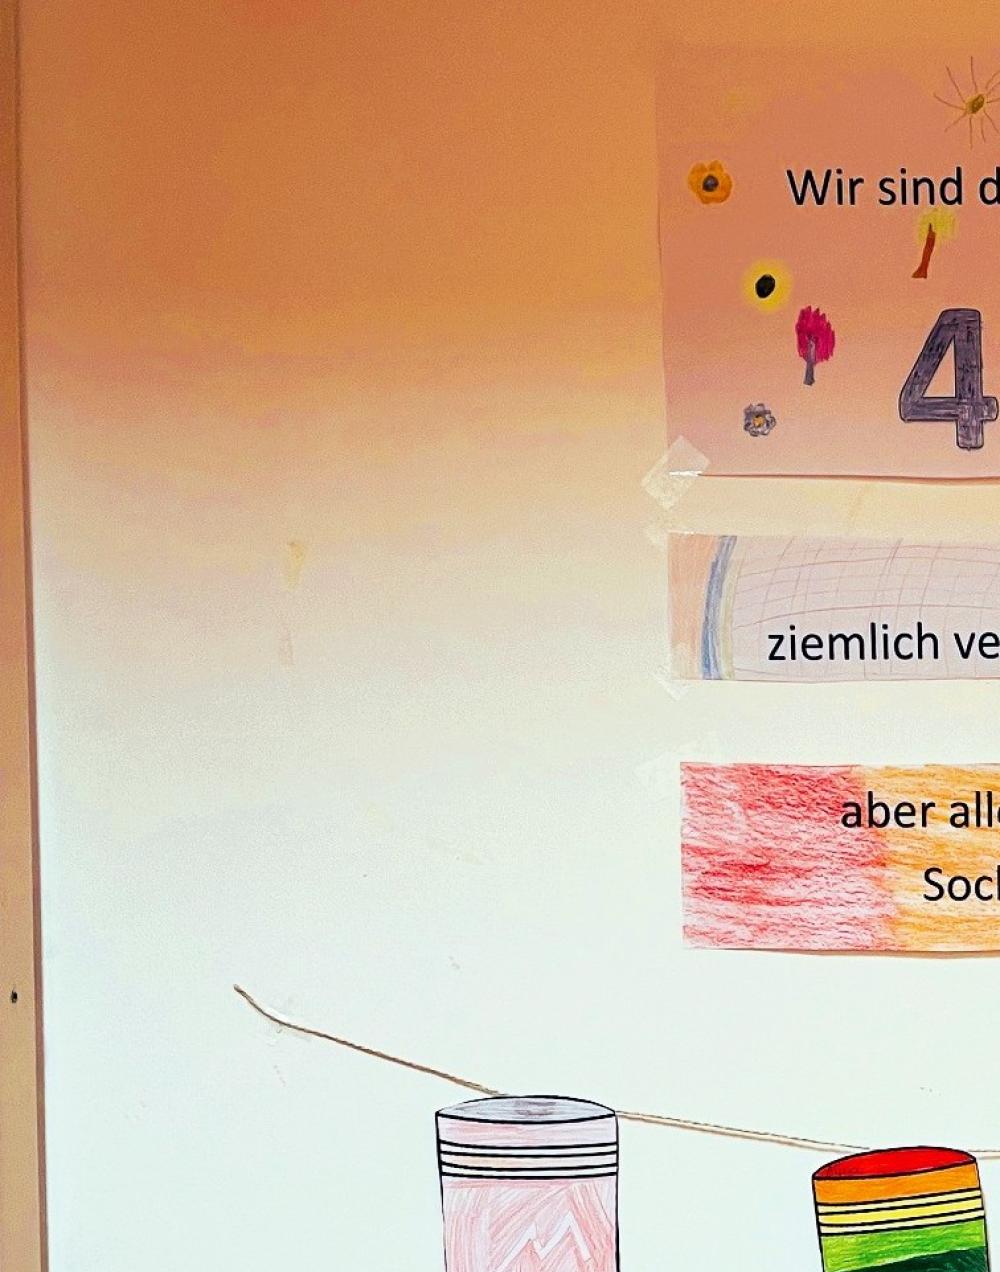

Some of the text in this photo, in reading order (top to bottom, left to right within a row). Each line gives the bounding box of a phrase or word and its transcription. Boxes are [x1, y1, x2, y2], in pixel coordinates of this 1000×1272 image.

[786, 168, 865, 206] Wir
[878, 166, 963, 206] sind
[767, 621, 939, 661] ziemlich
[841, 790, 936, 829] aber
